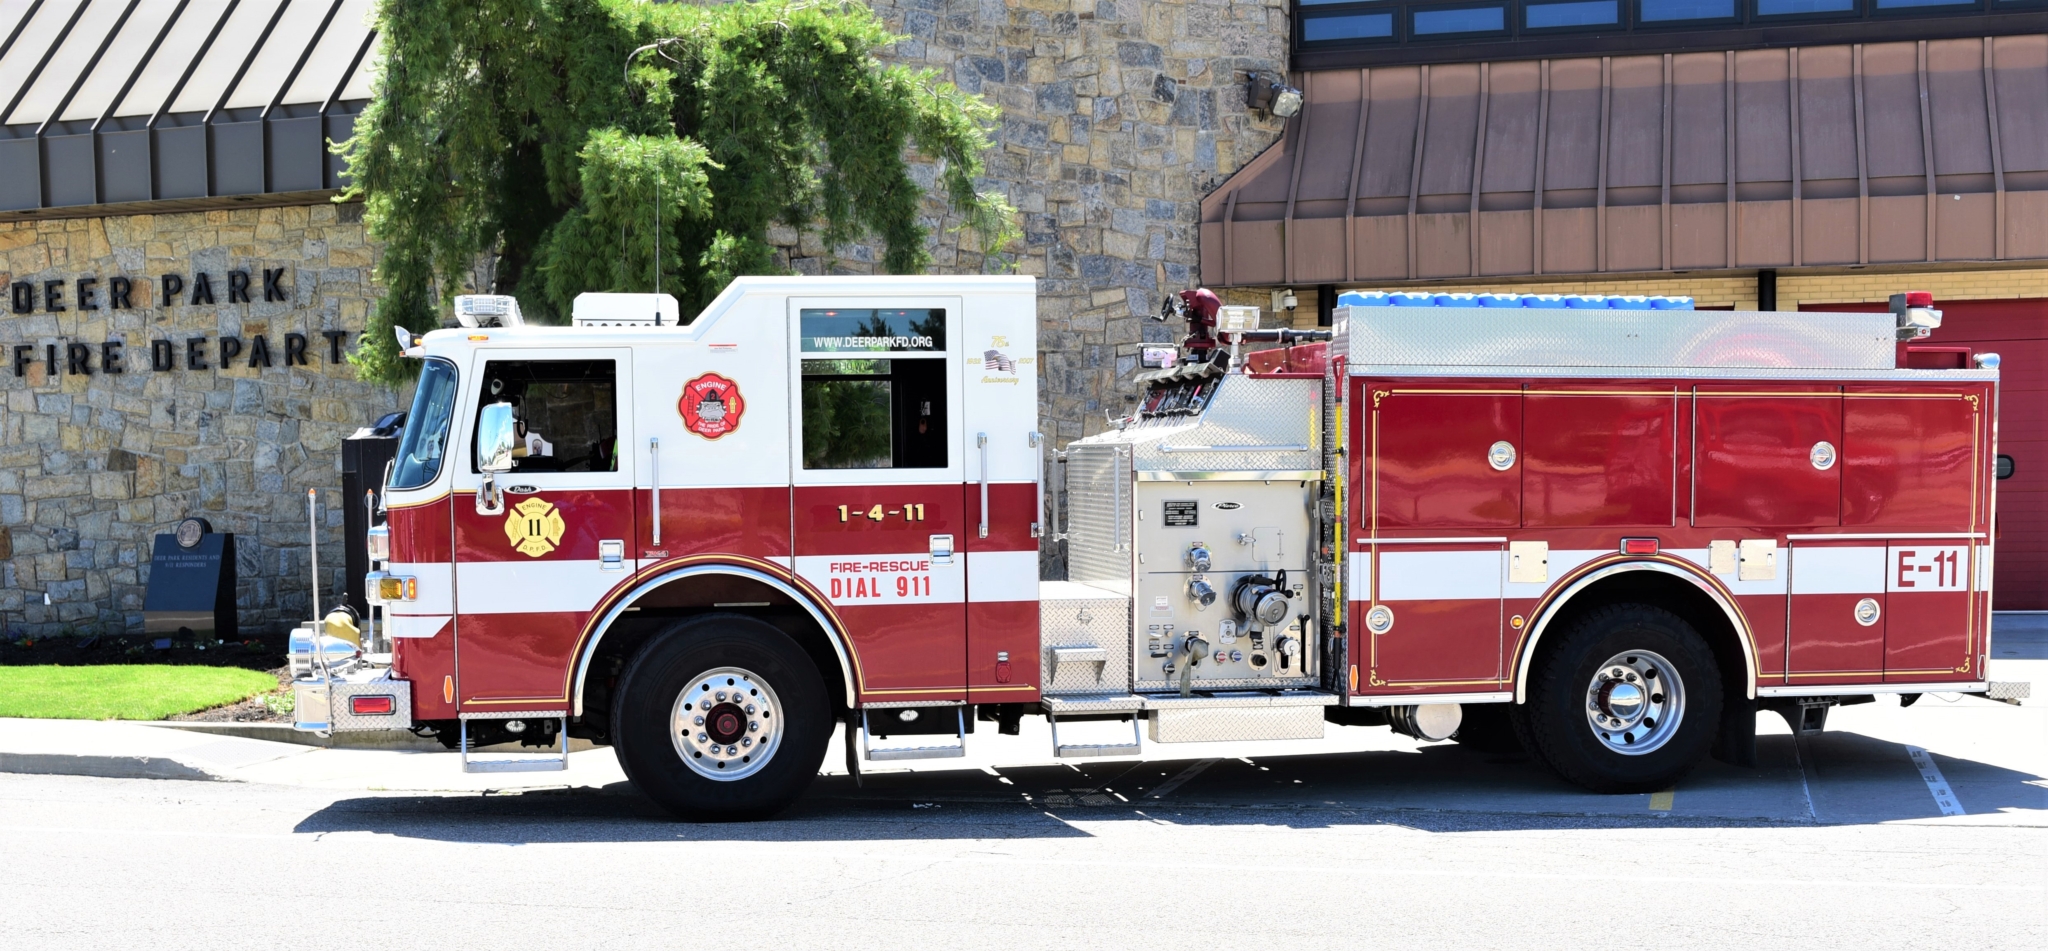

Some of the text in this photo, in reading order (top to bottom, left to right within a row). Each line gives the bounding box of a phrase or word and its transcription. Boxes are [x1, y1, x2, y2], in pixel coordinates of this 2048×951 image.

[11, 268, 286, 314] DEER PARK
[813, 336, 933, 348] WWW.DEERPARKFD.ORG
[14, 330, 369, 377] FIRE DEPART
[695, 381, 727, 391] ENGINE
[522, 503, 547, 511] ENGINE
[837, 503, 925, 522] 1-4-11
[528, 518, 541, 537] 11
[830, 561, 929, 573] FIRE-RESCUE
[1897, 550, 1958, 588] E-11
[830, 576, 930, 598] DIAL 911
